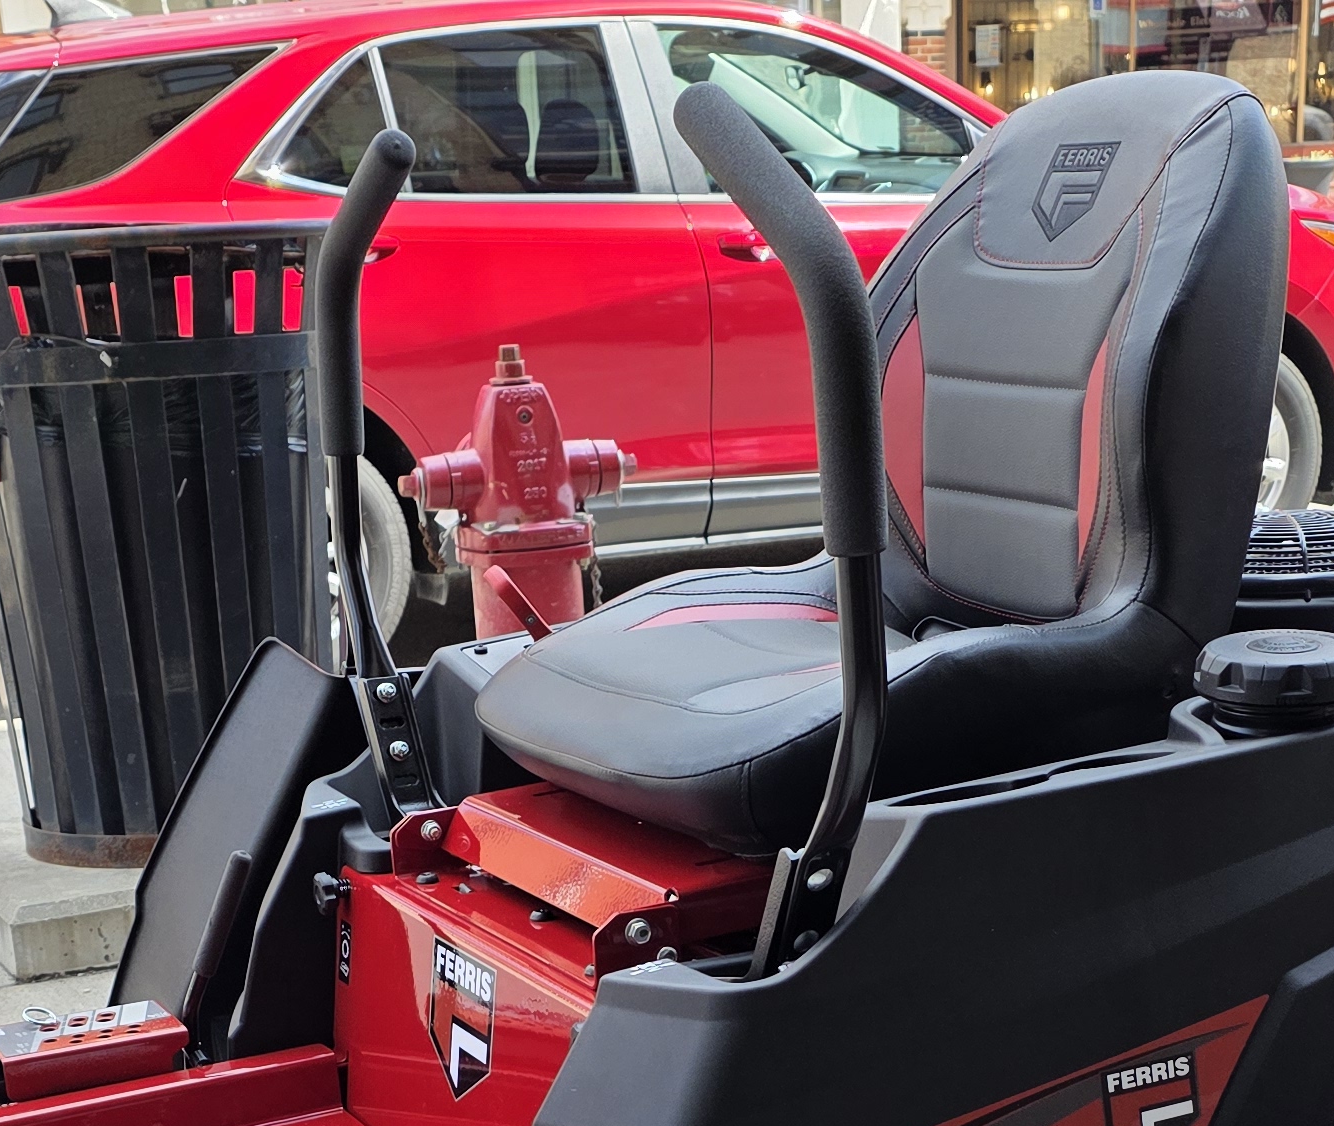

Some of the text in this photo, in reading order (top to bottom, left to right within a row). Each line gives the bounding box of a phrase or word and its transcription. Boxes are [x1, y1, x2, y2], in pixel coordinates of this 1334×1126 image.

[1054, 147, 1113, 167] FERRIS
[516, 457, 547, 473] 2017
[436, 944, 492, 1002] FERRIS
[1107, 1056, 1191, 1093] FERRIS
